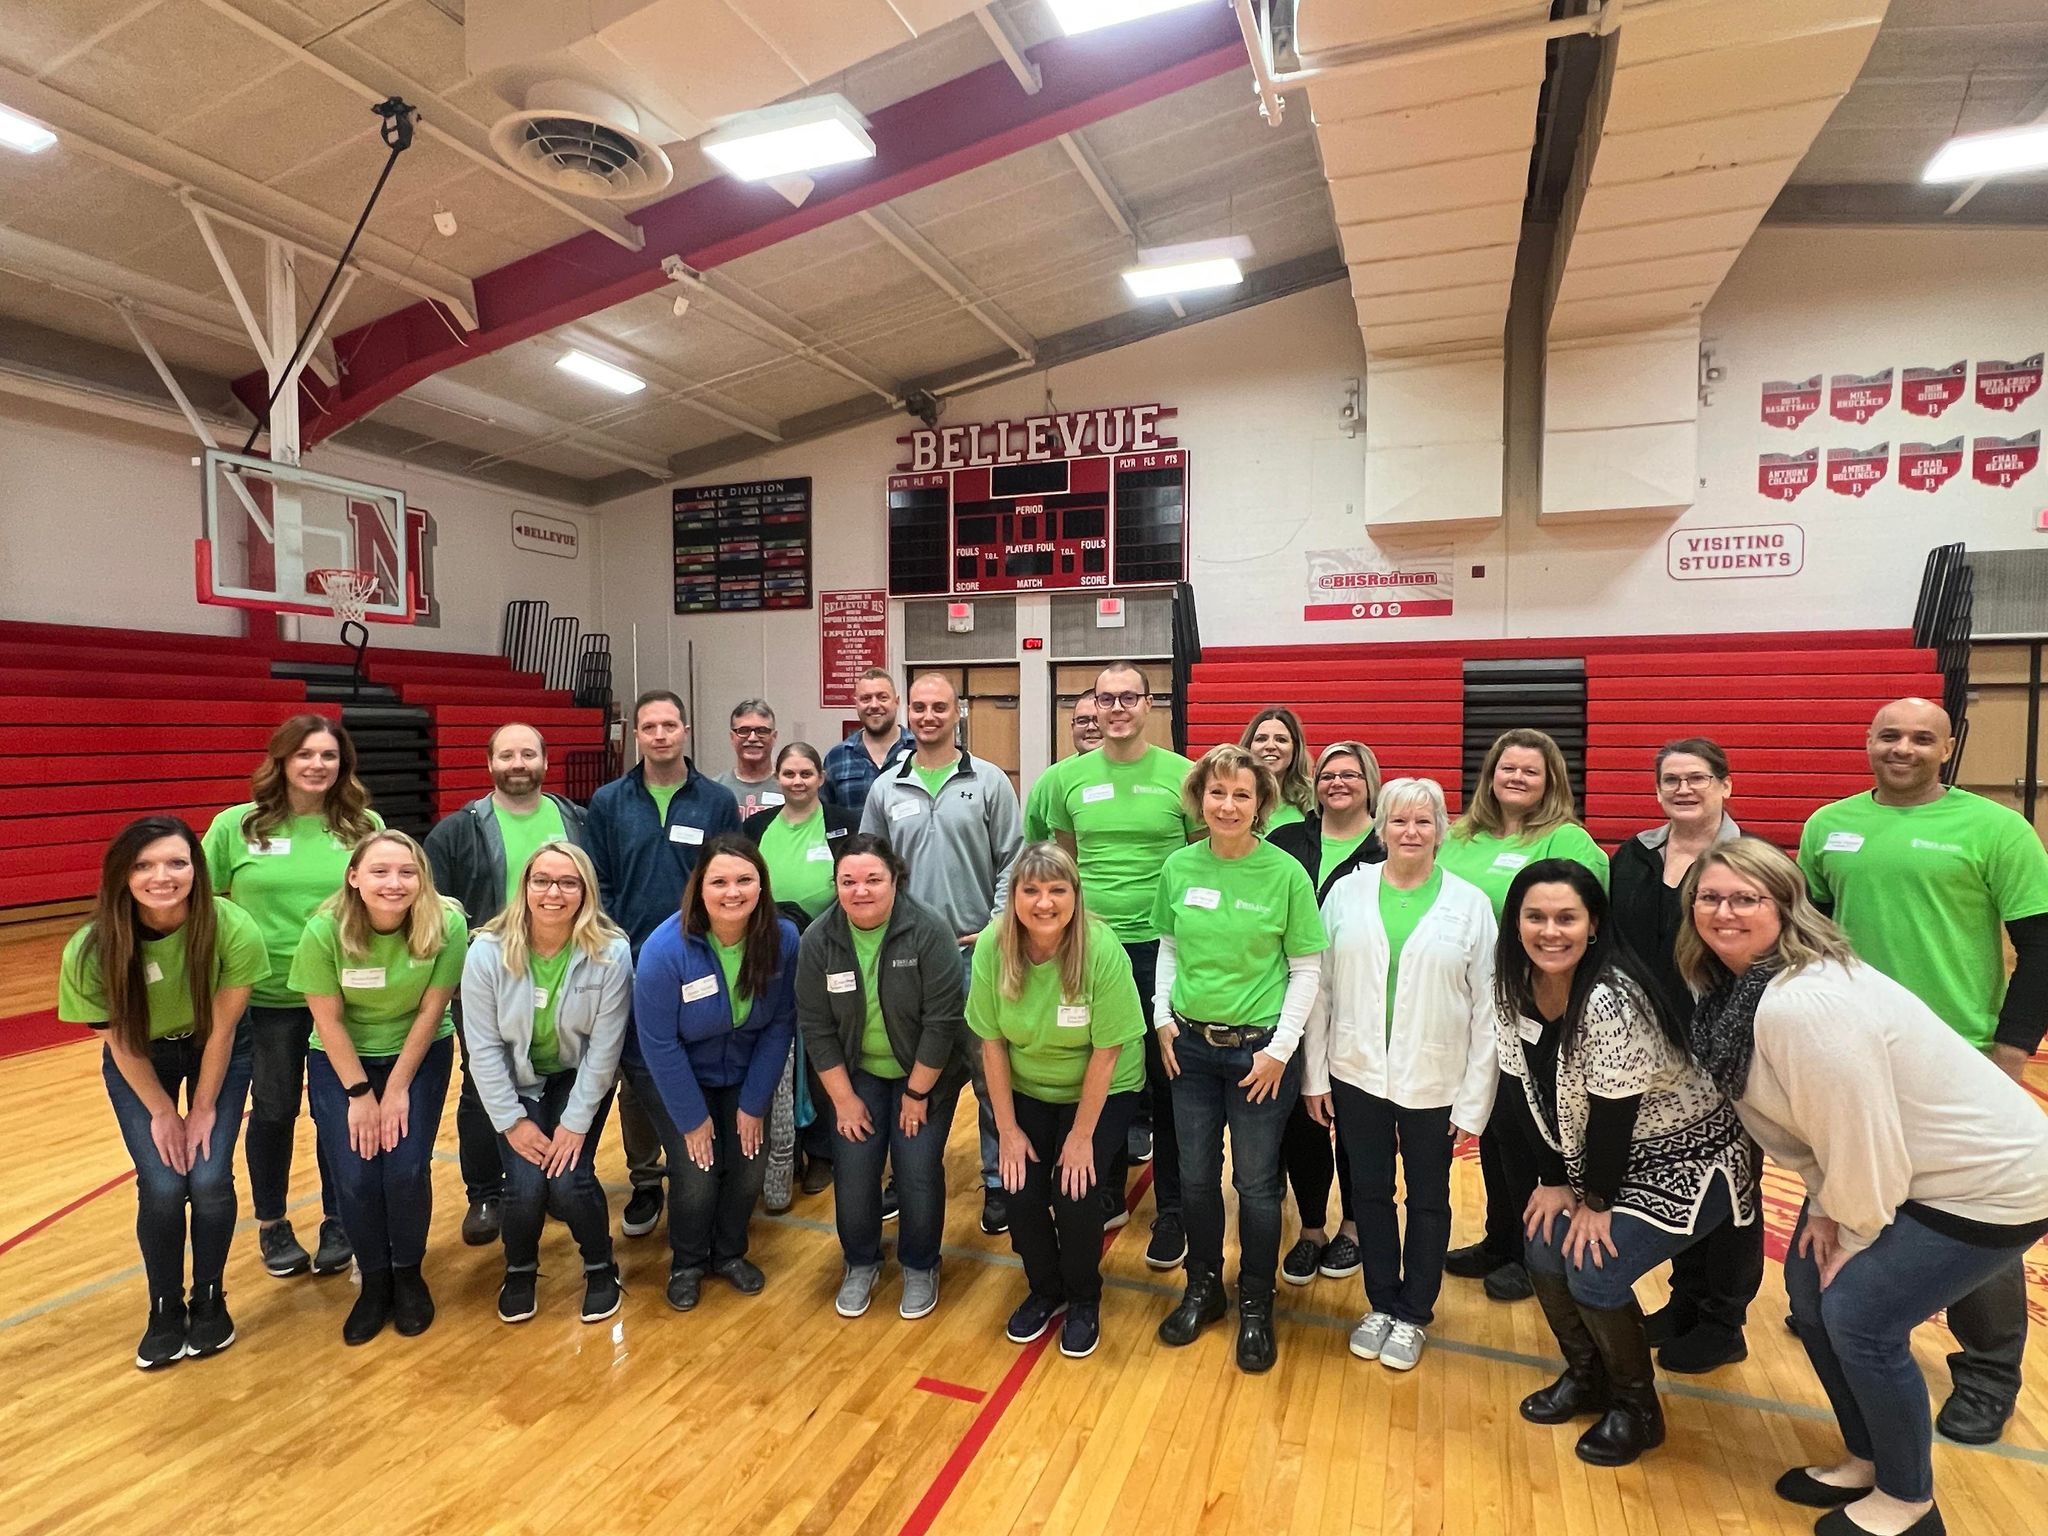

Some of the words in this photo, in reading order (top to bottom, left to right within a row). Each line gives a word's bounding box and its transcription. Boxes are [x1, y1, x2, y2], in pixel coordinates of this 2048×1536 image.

[2007, 375, 2037, 386] CROSS
[1985, 384, 2030, 395] COUNTRY
[1849, 391, 1871, 400] MILT
[1765, 402, 1816, 414] BASKETBALL
[912, 405, 1159, 471] BELLEVUE
[1119, 458, 1136, 468] PLYR
[1143, 456, 1156, 466] FLS
[1164, 454, 1178, 465] PTS
[1917, 459, 1943, 469] CHAD
[1991, 454, 2018, 464] CHAD
[1768, 468, 1809, 479] ANTHONY
[1768, 476, 1808, 486] COLEMAN
[696, 489, 724, 499] LAKE
[730, 483, 785, 496] DIVISION
[1016, 504, 1044, 515] PERIOD
[523, 525, 576, 546] BELLEVUE
[1005, 544, 1034, 554] PLAYER
[1036, 543, 1056, 552] FOUL
[1081, 539, 1107, 550] FOULS
[1687, 534, 1785, 552] VISITING
[956, 547, 980, 557] FOULS
[1679, 552, 1791, 571] STUDENTS
[1016, 579, 1043, 588] MATCH
[1081, 575, 1107, 586] SCORE
[1319, 571, 1438, 589] @BHSRedmen
[956, 582, 980, 591] SCORE
[823, 600, 869, 616] BELLEVUE
[871, 599, 884, 614] HS
[823, 629, 885, 638] EXPECTATION
